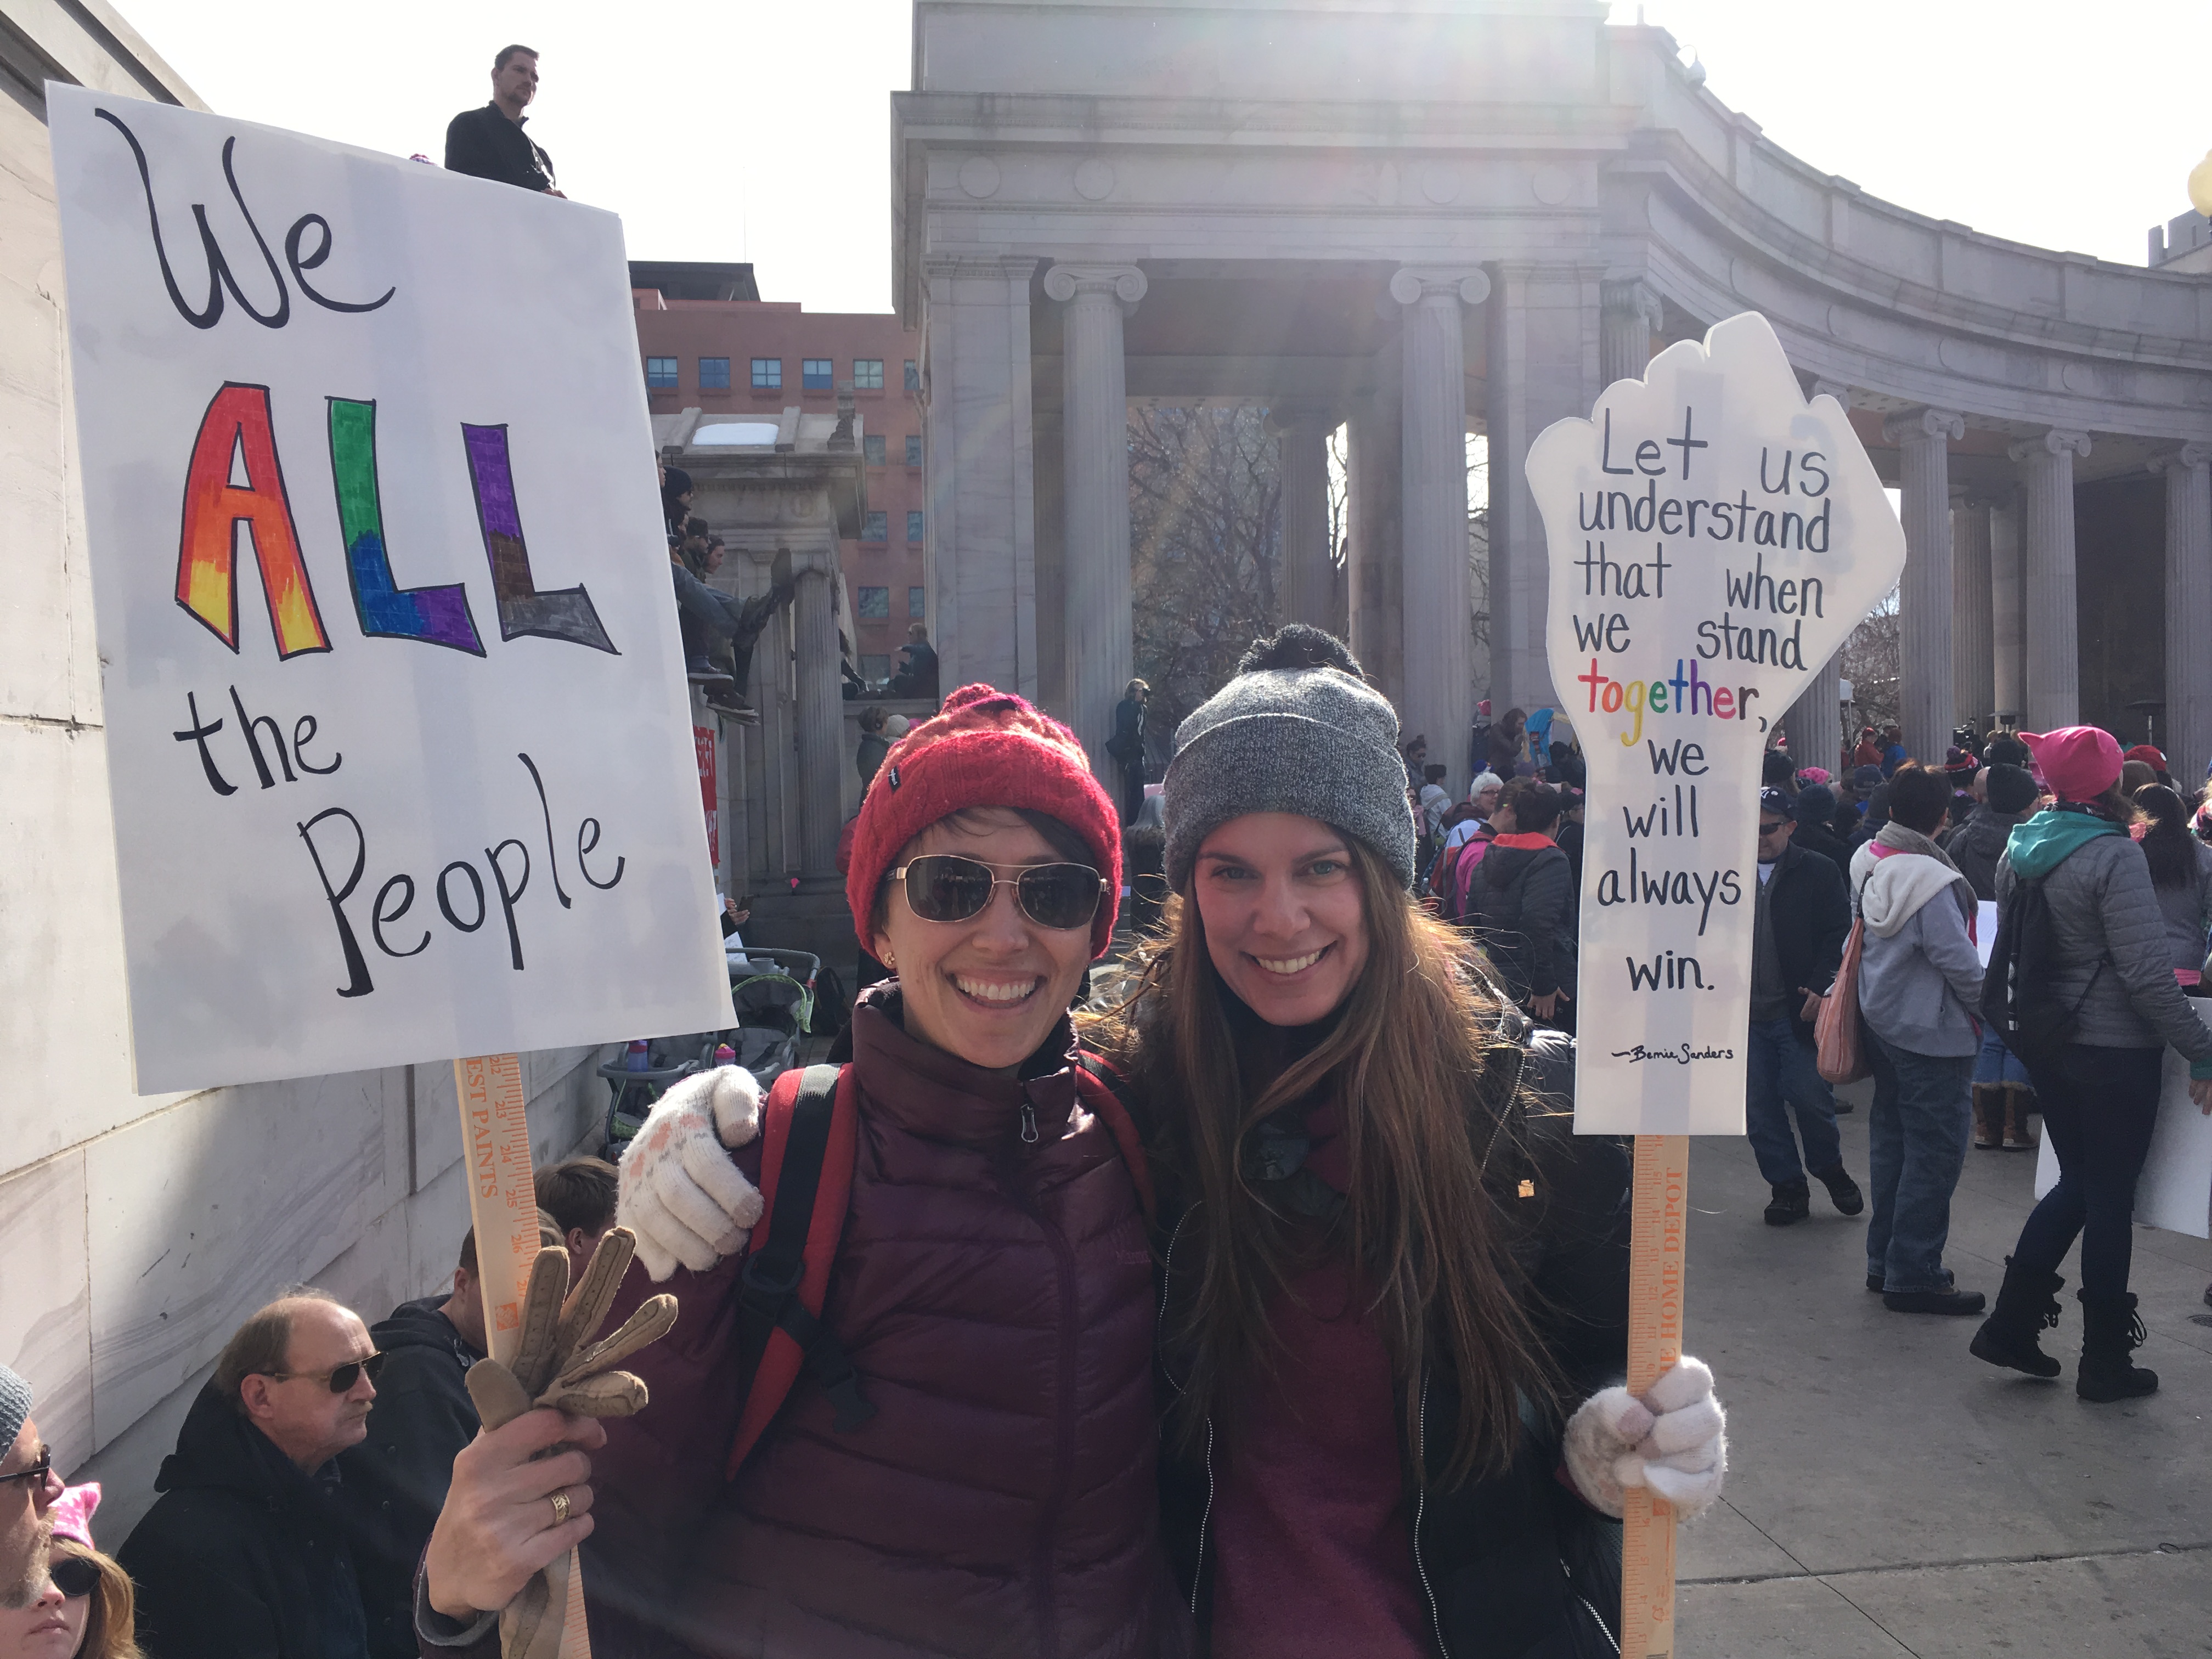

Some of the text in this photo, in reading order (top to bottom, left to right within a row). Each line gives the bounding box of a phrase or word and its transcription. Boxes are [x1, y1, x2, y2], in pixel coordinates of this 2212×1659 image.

[95, 108, 397, 330] We
[1602, 406, 1830, 497] Let us
[174, 380, 623, 662] ALL
[1579, 478, 1831, 553] understand
[1573, 540, 1824, 618] that when
[1573, 612, 1808, 672] we stand
[173, 684, 342, 797] the
[1577, 658, 1768, 747] together,
[1647, 738, 1709, 776] we
[1622, 784, 1699, 838] will
[297, 752, 625, 998] People
[1597, 847, 1741, 936] always
[1626, 950, 1715, 992] win.
[1677, 1043, 1734, 1064] Sanders
[472, 1108, 498, 1199] PAINTS
[1664, 1167, 1683, 1252] DEPOT
[1661, 1261, 1679, 1340] HOME
